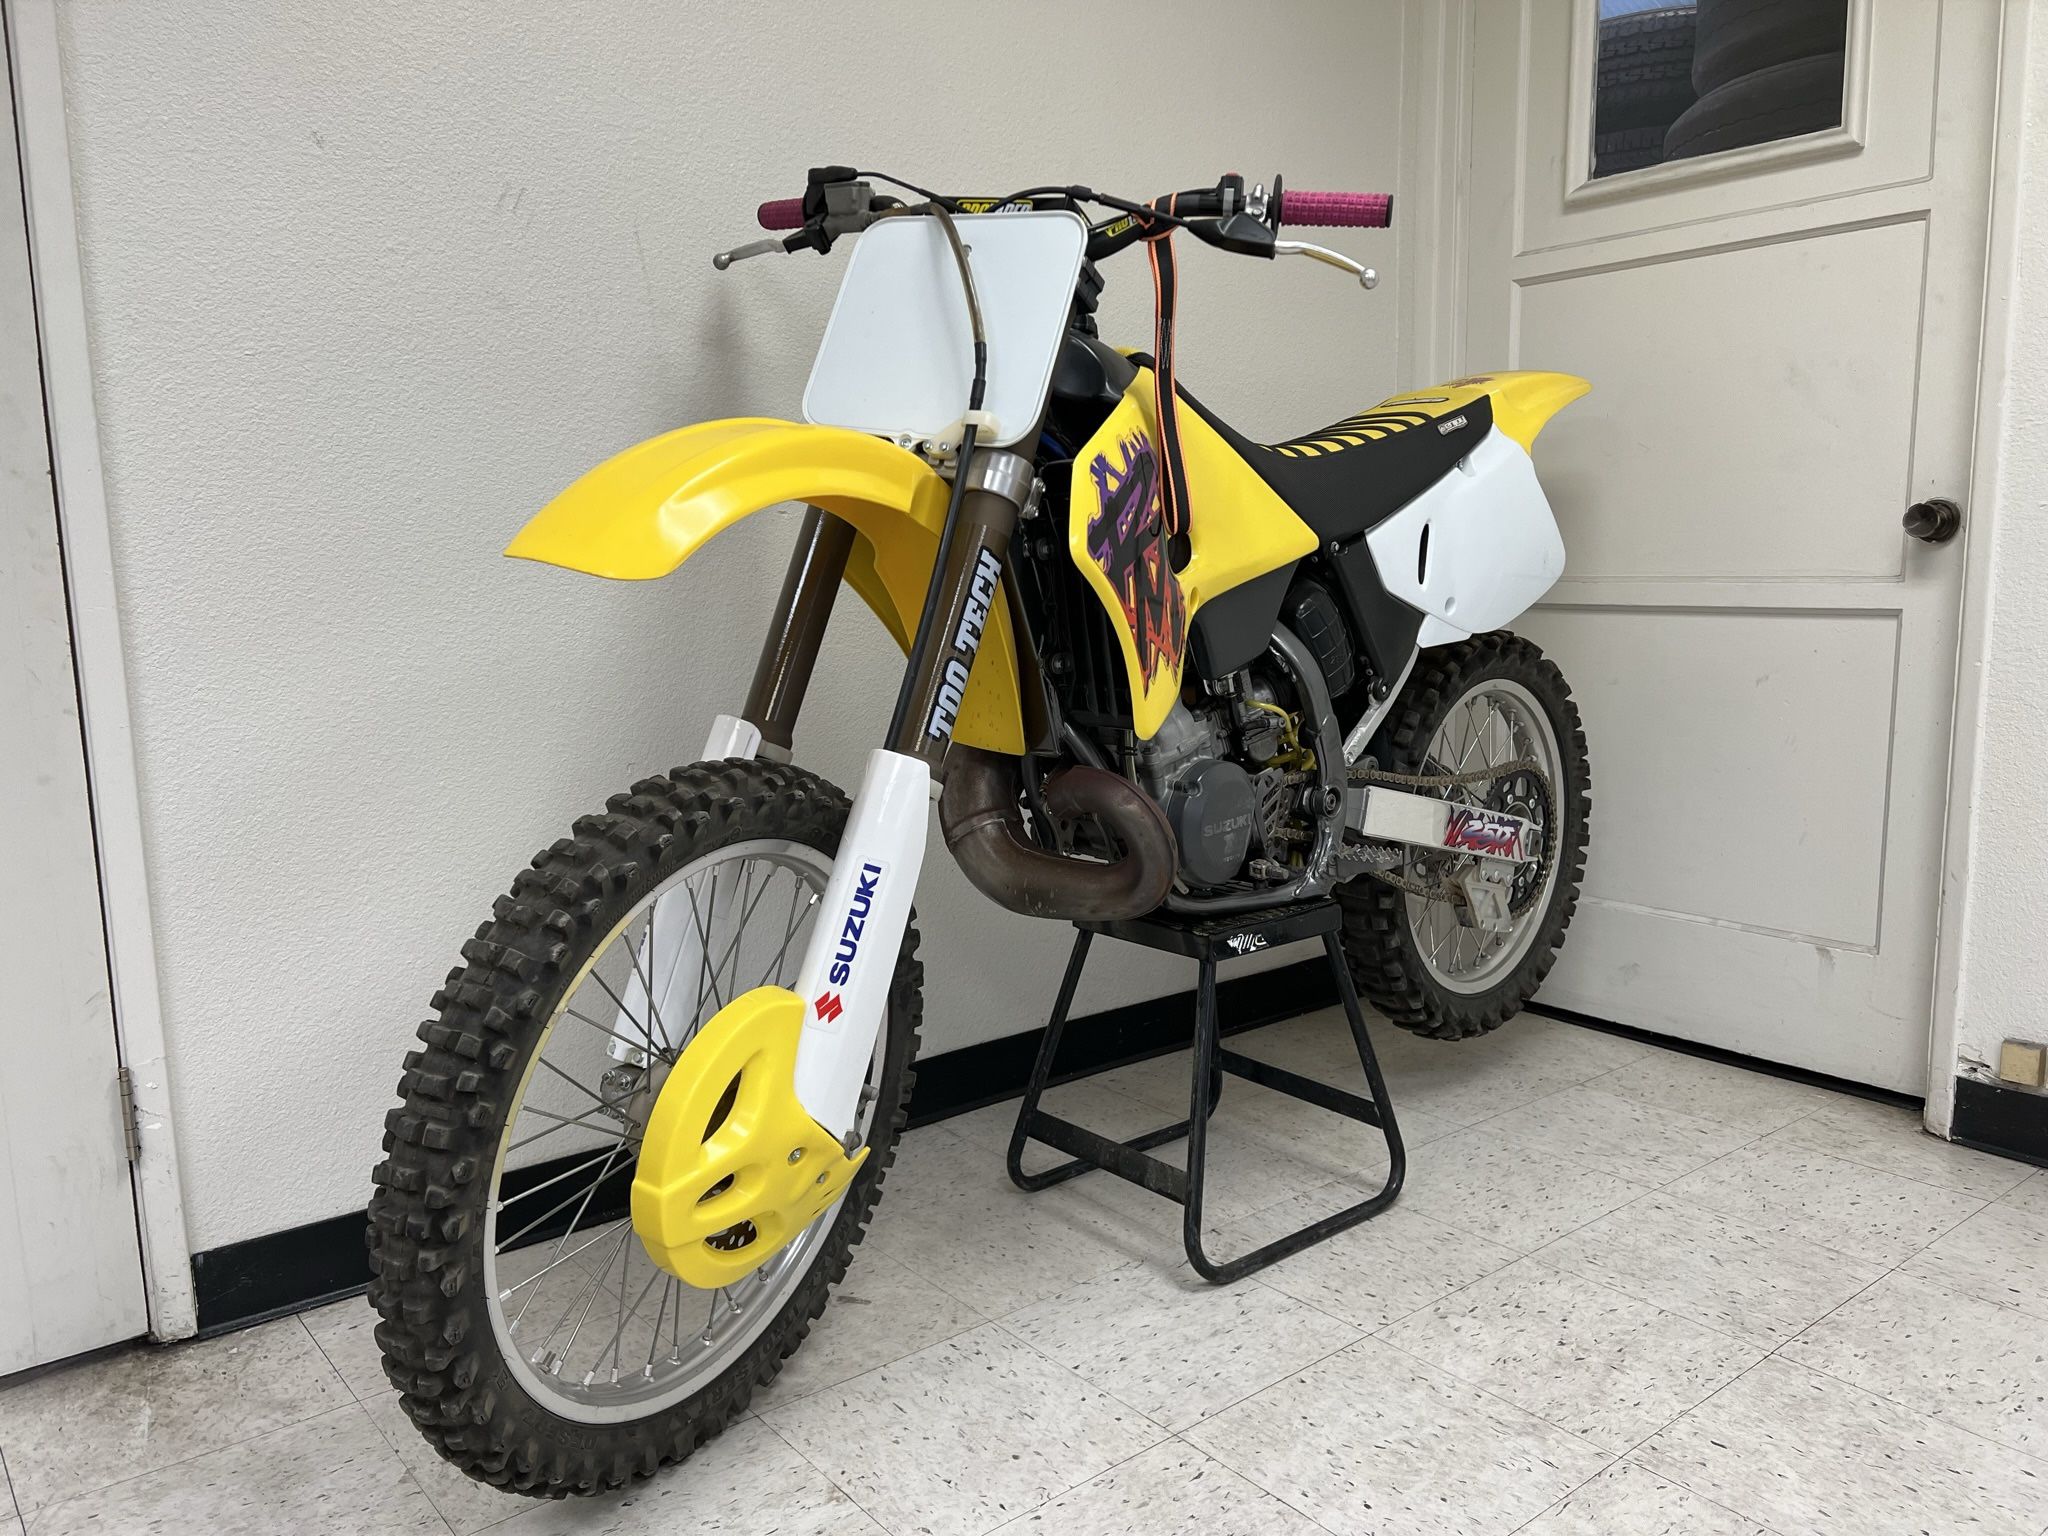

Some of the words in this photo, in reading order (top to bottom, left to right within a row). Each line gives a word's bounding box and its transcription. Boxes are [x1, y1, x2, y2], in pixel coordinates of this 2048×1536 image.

[929, 659, 970, 740] TOO
[955, 549, 1002, 655] TECH
[1202, 813, 1252, 838] SUZUKI
[830, 862, 882, 987] SUZUKI
